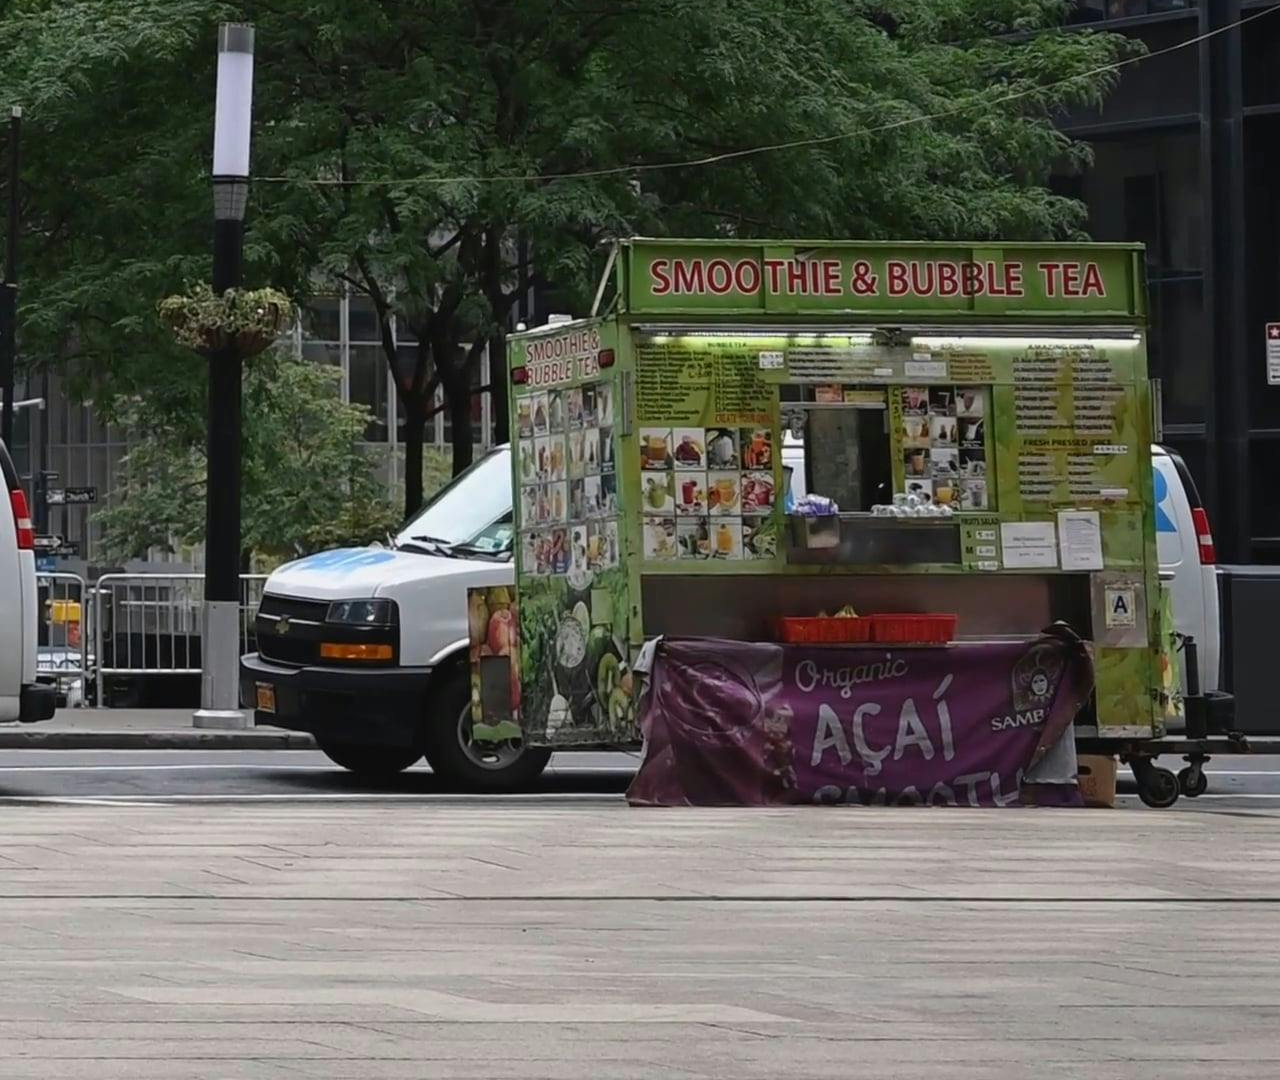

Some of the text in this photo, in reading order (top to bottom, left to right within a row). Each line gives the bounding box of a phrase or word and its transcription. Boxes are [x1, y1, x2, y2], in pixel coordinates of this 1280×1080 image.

[650, 258, 1106, 298] SMOOTHIE & BUBBLE TEA
[526, 332, 589, 363] SMOOTHIE
[526, 356, 600, 387] BUBBLE TEA
[1113, 595, 1128, 614] A
[795, 652, 908, 698] Organic
[810, 673, 955, 776] AÇAÍ
[991, 708, 1050, 731] SAMB
